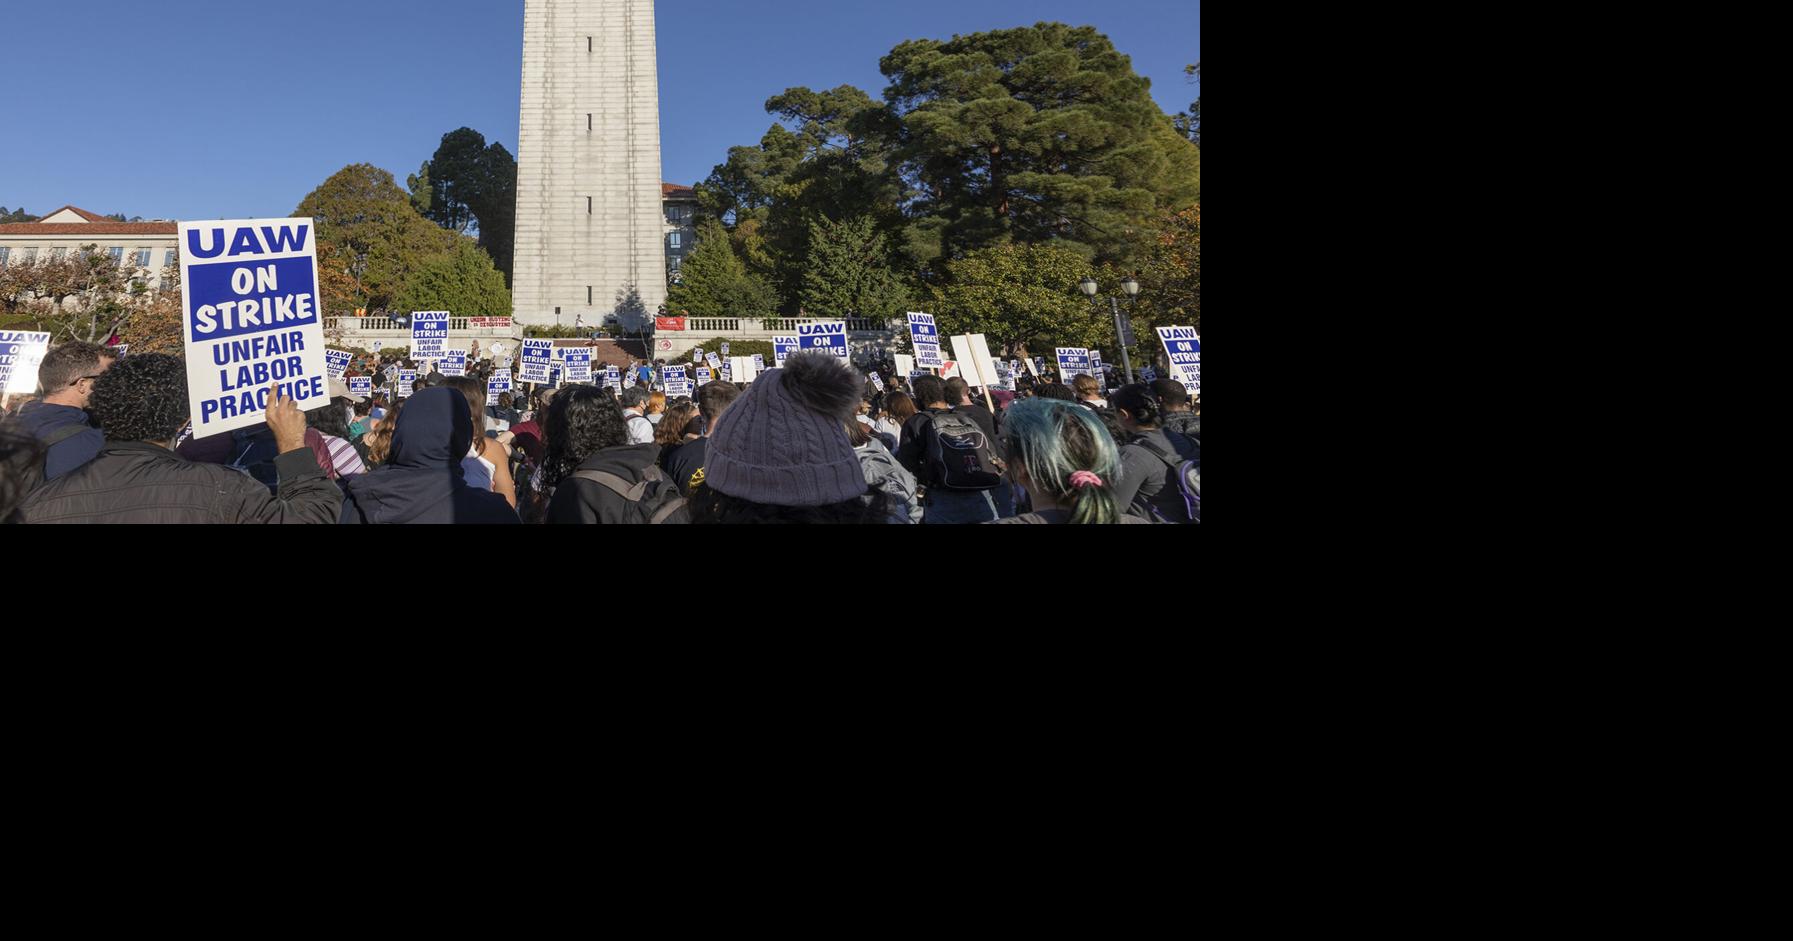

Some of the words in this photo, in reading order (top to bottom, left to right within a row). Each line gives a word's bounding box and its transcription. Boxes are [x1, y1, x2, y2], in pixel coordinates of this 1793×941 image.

[188, 225, 308, 258] UAW
[232, 264, 278, 294] ON
[196, 294, 312, 334] STRIKE
[909, 314, 932, 324] UAW
[799, 324, 842, 334] UAW
[1160, 329, 1194, 338] UAW
[813, 337, 831, 346] ON
[913, 334, 937, 343] STRIKE
[213, 331, 304, 366] UNFAIR
[1177, 342, 1192, 351] ON
[326, 350, 351, 358] UAW
[1172, 352, 1200, 362] STRIK
[220, 356, 303, 392] LABOR
[201, 376, 324, 424] PRACTICE
